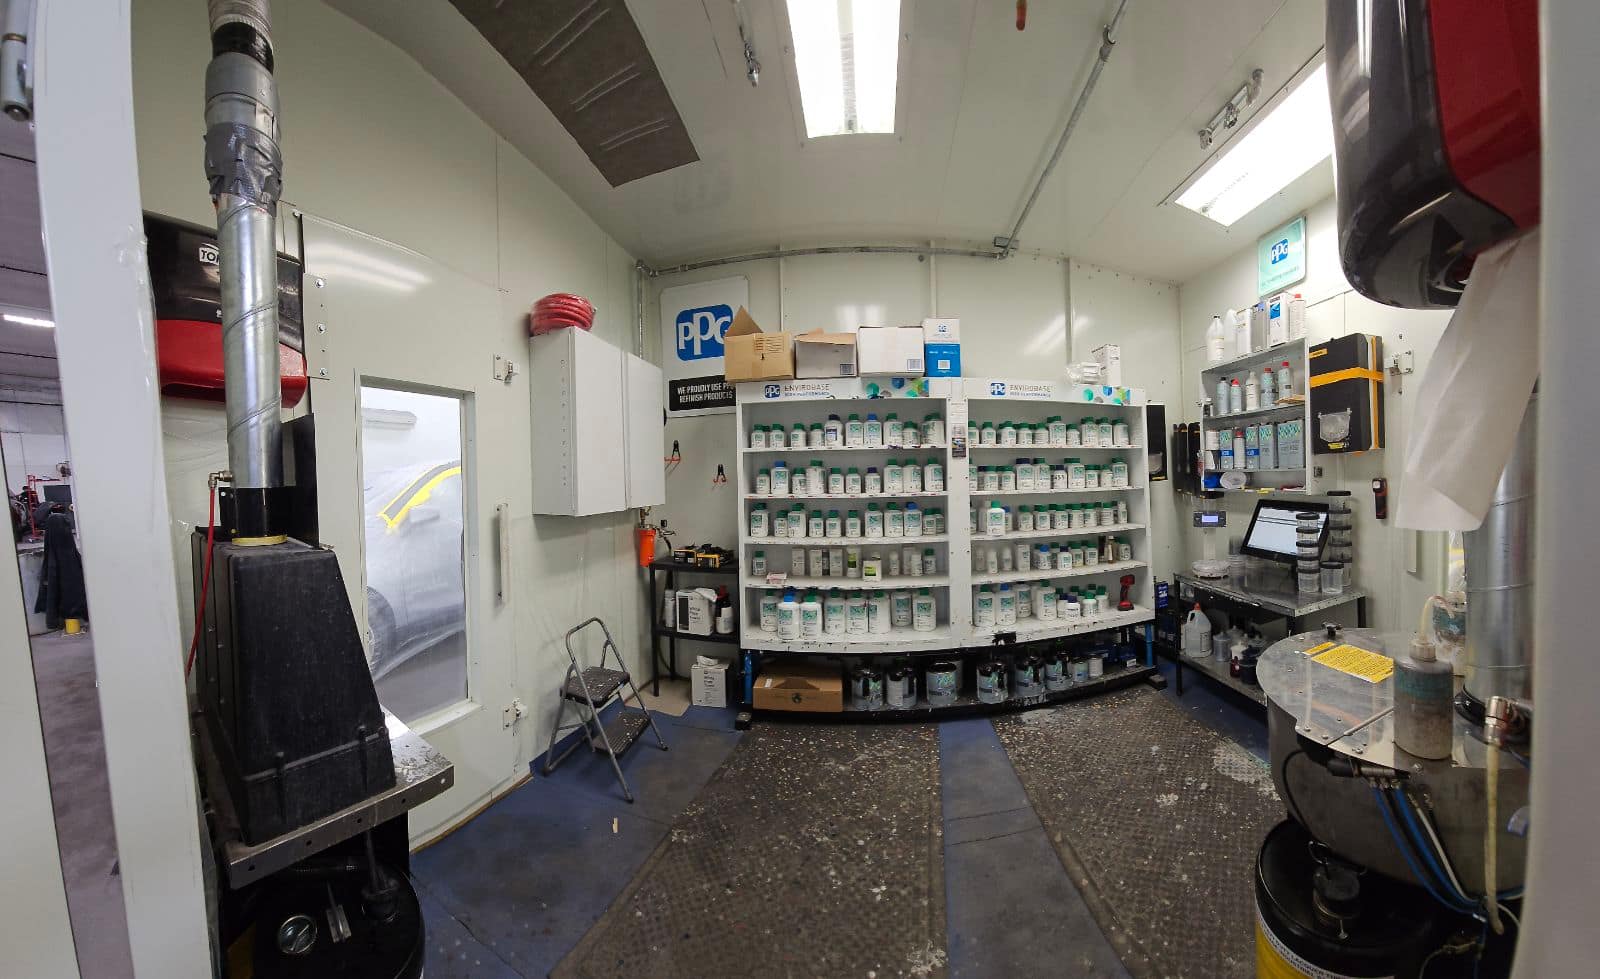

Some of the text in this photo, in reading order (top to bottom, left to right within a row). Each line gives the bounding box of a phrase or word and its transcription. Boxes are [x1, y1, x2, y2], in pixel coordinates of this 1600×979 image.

[1271, 241, 1288, 264] PPG
[678, 311, 731, 355] PPG
[677, 386, 687, 395] WE
[687, 384, 711, 394] PROUDLY
[711, 382, 722, 391] USE
[764, 385, 780, 398] PPG
[784, 383, 830, 392] ENVIROBASE
[680, 391, 733, 403] REFINISH PRODUCTS
